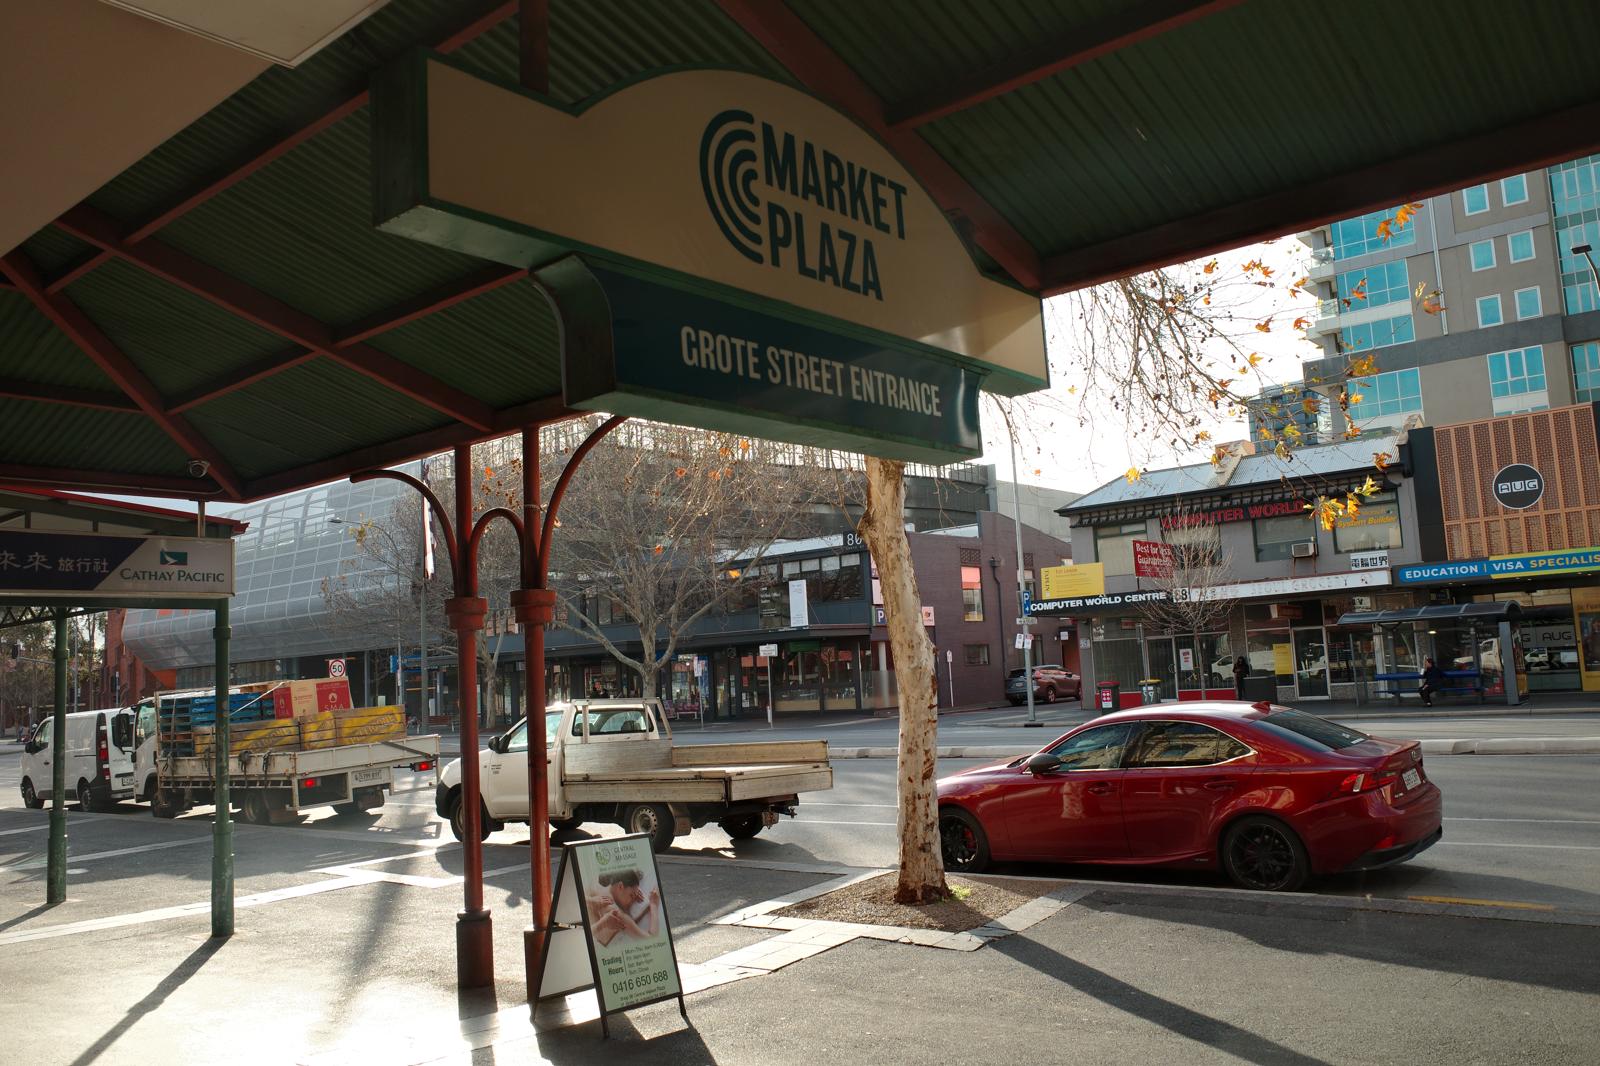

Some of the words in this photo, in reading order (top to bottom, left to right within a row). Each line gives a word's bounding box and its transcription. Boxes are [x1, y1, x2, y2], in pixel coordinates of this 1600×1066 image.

[762, 121, 907, 240] MARKET
[767, 201, 884, 301] PLAZA
[681, 325, 761, 379] GROTE
[766, 345, 844, 397] STREET
[850, 365, 942, 417] ENTRANCE
[1498, 479, 1538, 493] AUG
[1250, 499, 1305, 518] WORLD
[120, 568, 174, 581] CATHAY
[177, 570, 225, 583] PACIFIC
[1405, 564, 1479, 580] EDUCATION
[1492, 561, 1525, 572] VISA
[1030, 600, 1083, 612] COMPUTER
[1085, 595, 1122, 607] WORLD
[1124, 591, 1167, 603] CENTRE
[1542, 631, 1572, 641] AUG
[332, 664, 343, 673] 50
[612, 978, 634, 994] 0416
[635, 974, 651, 988] 650
[652, 970, 669, 983] 688
